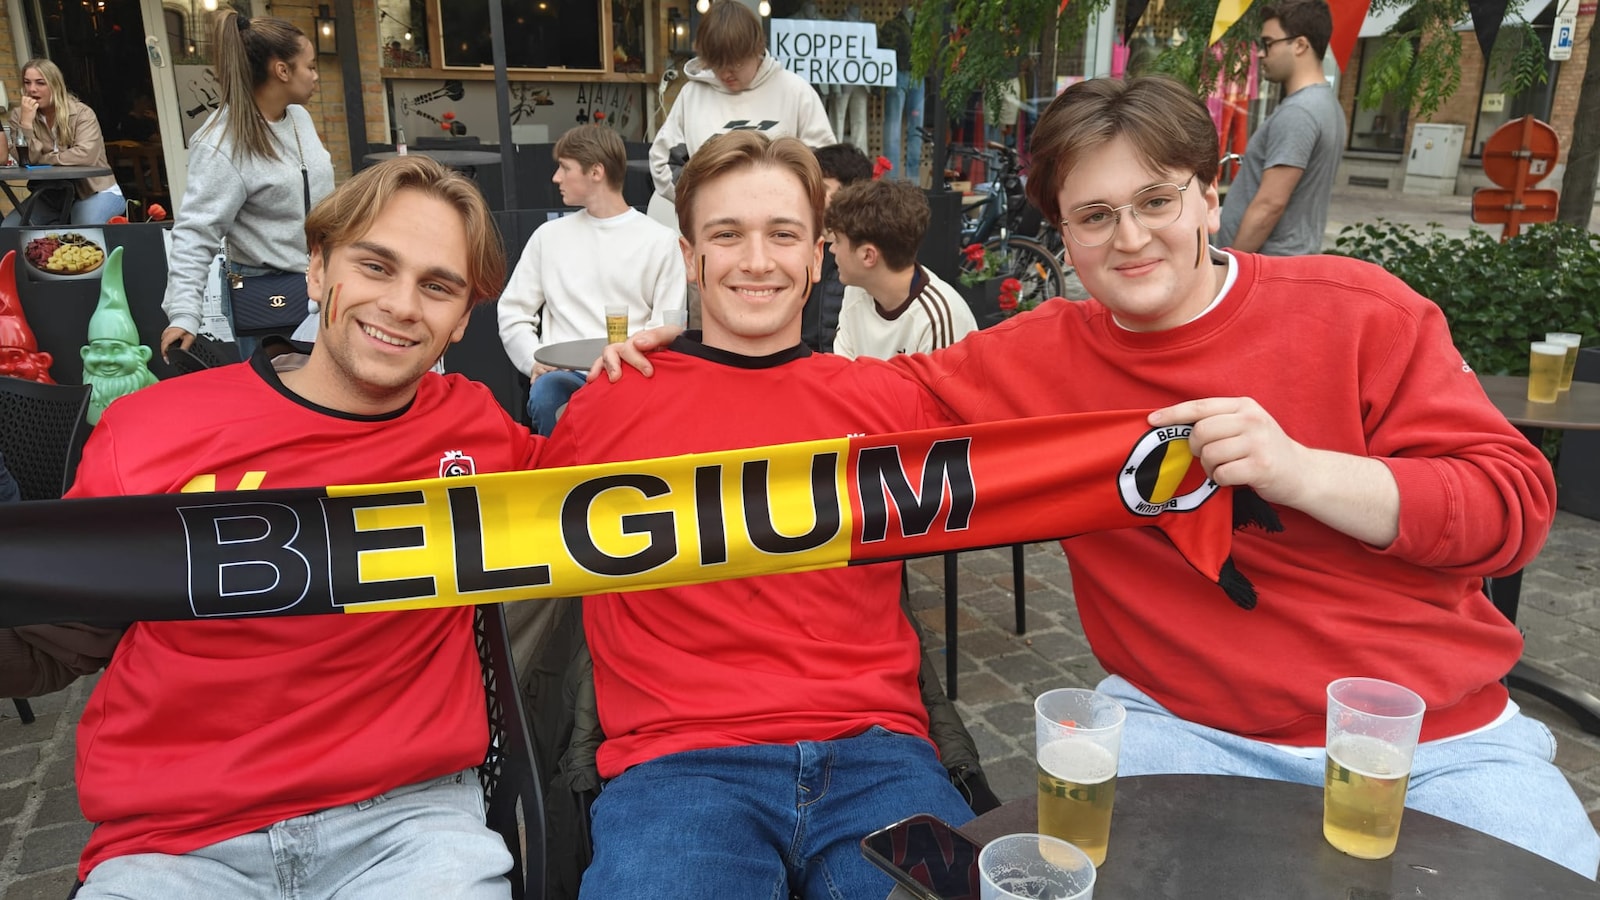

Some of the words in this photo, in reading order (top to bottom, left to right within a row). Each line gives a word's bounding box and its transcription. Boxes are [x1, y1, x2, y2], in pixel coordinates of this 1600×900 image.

[776, 32, 872, 59] KOPPEL
[576, 83, 587, 104] A
[176, 437, 976, 617] BELGIUM
